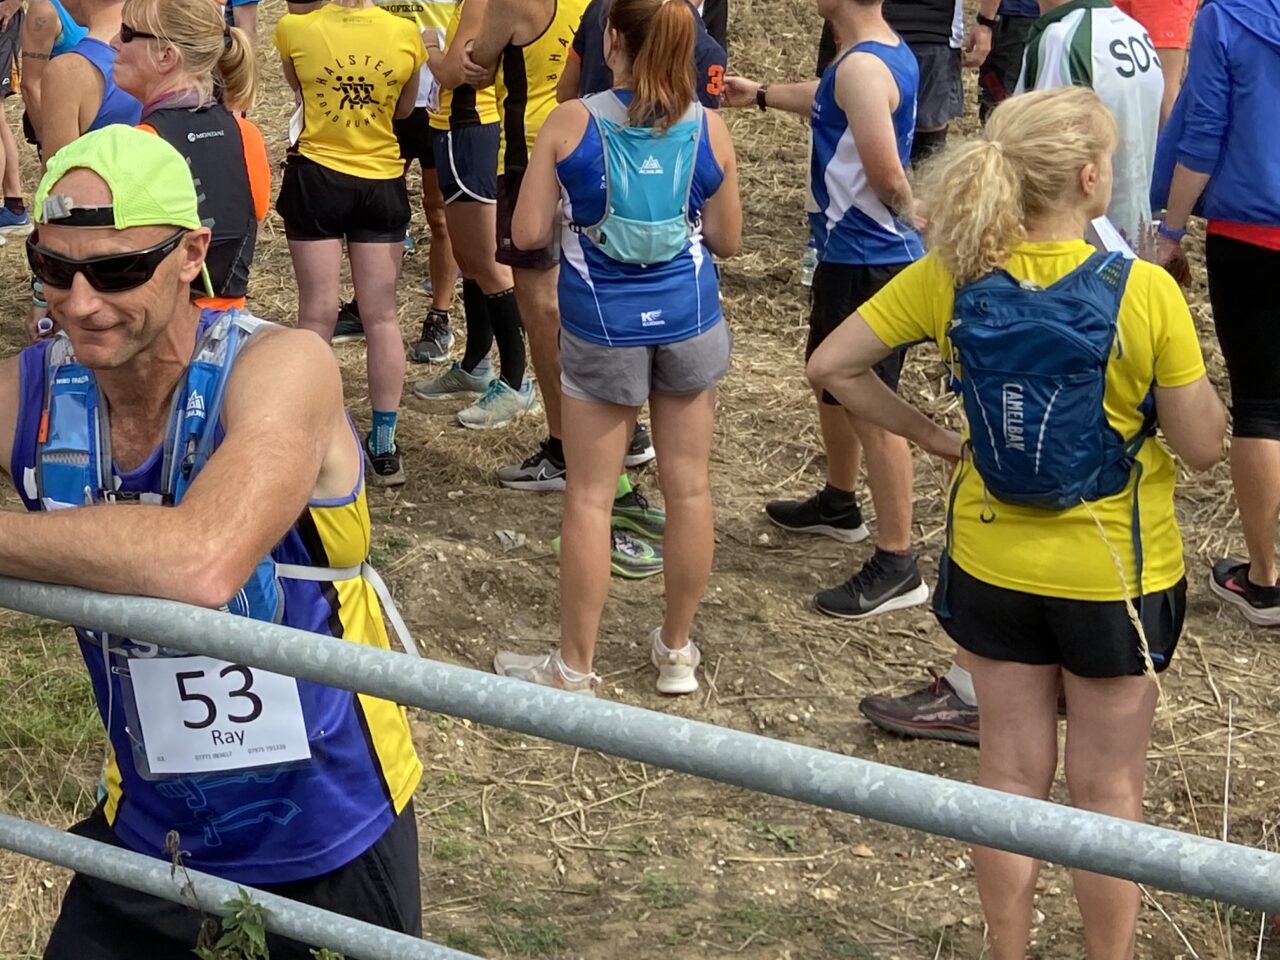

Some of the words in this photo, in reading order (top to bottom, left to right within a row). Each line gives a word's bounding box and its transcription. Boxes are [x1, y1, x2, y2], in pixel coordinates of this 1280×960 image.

[315, 54, 398, 87] HALSTEAD
[706, 64, 725, 96] 3
[1002, 383, 1025, 452] CAMELBAK
[176, 663, 263, 730] 53
[211, 727, 246, 746] Ray
